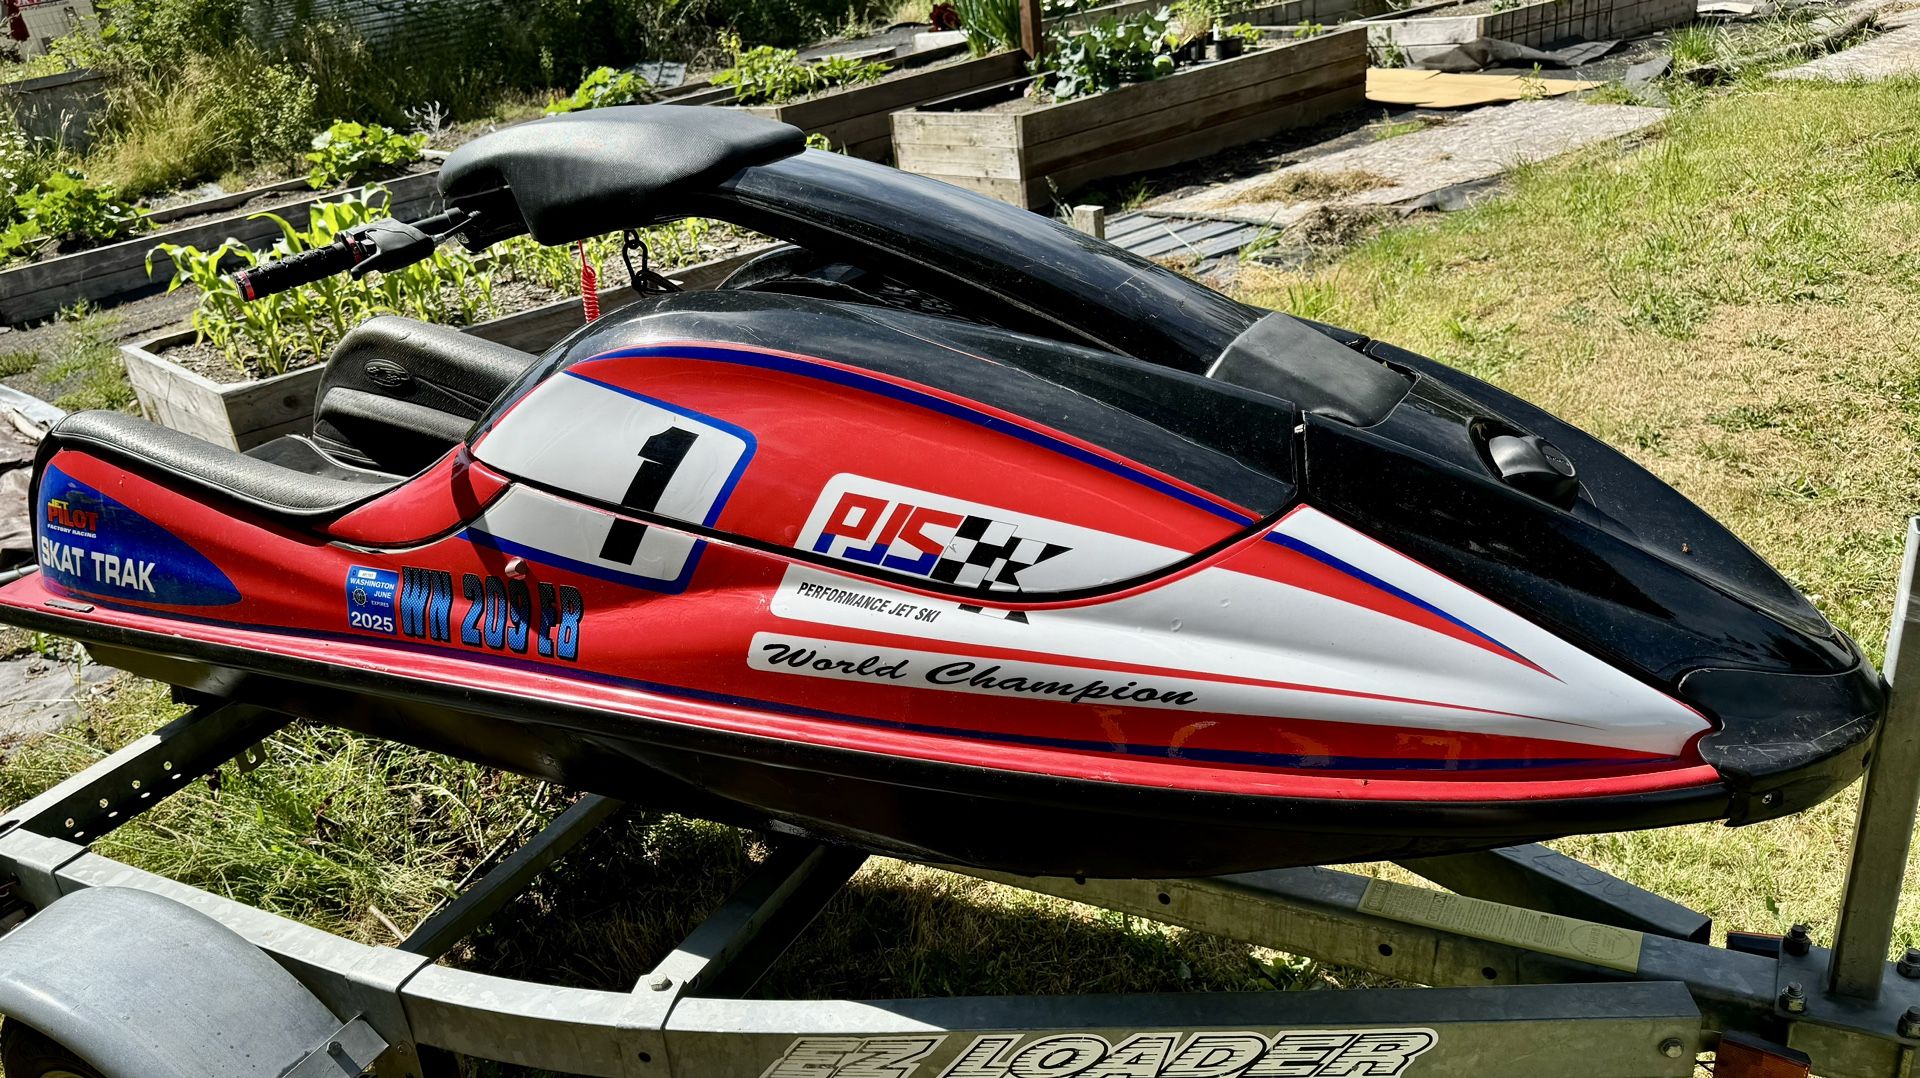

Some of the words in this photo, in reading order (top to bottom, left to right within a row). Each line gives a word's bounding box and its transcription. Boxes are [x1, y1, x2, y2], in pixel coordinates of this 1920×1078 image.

[47, 498, 68, 509] JET
[599, 426, 699, 565] 1
[47, 506, 97, 531] PILOT
[47, 523, 71, 533] FACTORY
[72, 530, 96, 538] RACING
[812, 491, 965, 576] PJS
[41, 536, 85, 577] SKAT
[90, 551, 156, 593] TRAK
[350, 578, 394, 589] WASHINGTON
[373, 590, 392, 599] JUNE
[371, 600, 389, 608] EXPIRES
[401, 566, 452, 642] WN
[461, 573, 531, 652] 209
[537, 582, 584, 660] EB
[797, 581, 891, 613] PERFORMANCE
[888, 603, 918, 618] JET
[914, 608, 941, 623] SKI
[351, 611, 394, 632] 2025
[763, 643, 909, 679] World
[925, 661, 1198, 704] Champion
[937, 1028, 1438, 1078] LOADER
